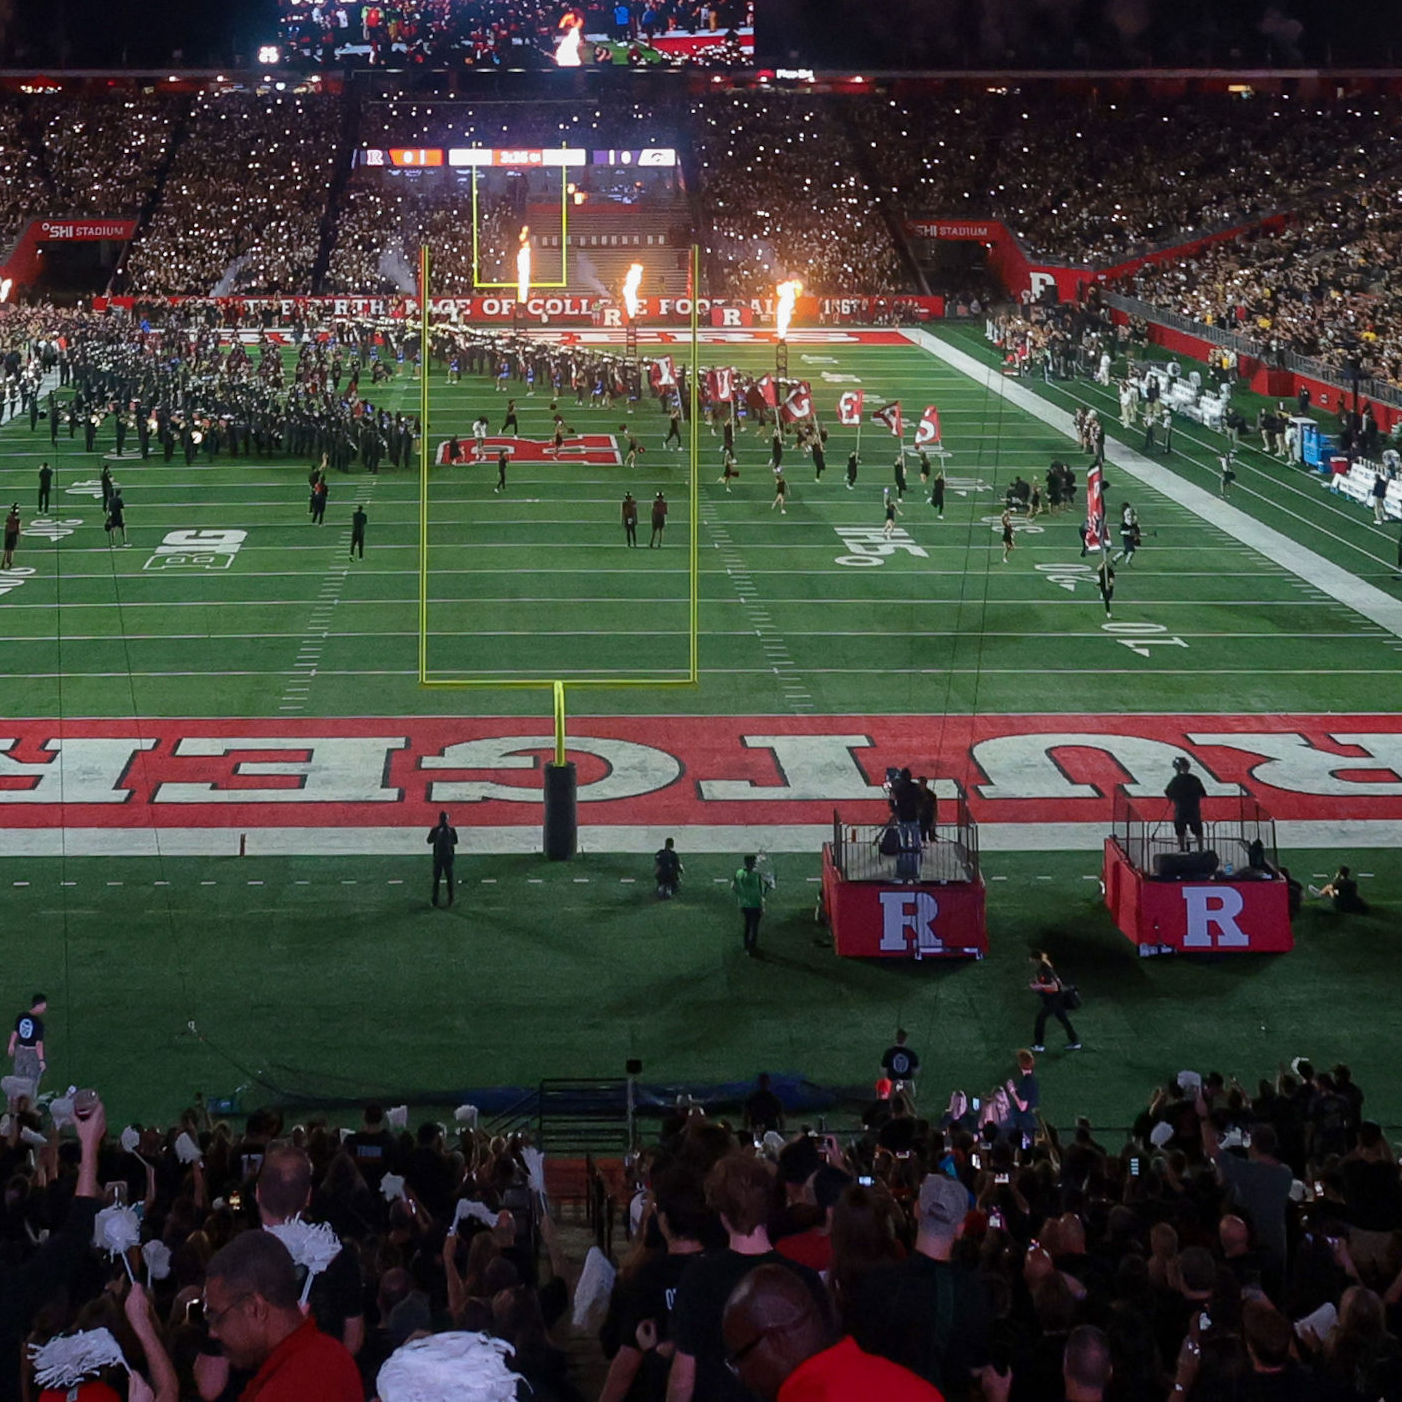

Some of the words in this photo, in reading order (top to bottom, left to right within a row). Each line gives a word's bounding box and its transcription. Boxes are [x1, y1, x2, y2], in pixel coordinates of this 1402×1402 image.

[49, 226, 73, 238] SHI
[75, 225, 124, 237] STADIUM
[939, 225, 987, 237] STADIUM
[482, 299, 516, 316] OF
[604, 309, 622, 326] R
[722, 309, 742, 326] R
[840, 392, 861, 424] E
[1101, 622, 1190, 648] 10
[879, 891, 943, 951] R
[1182, 886, 1250, 947] R
